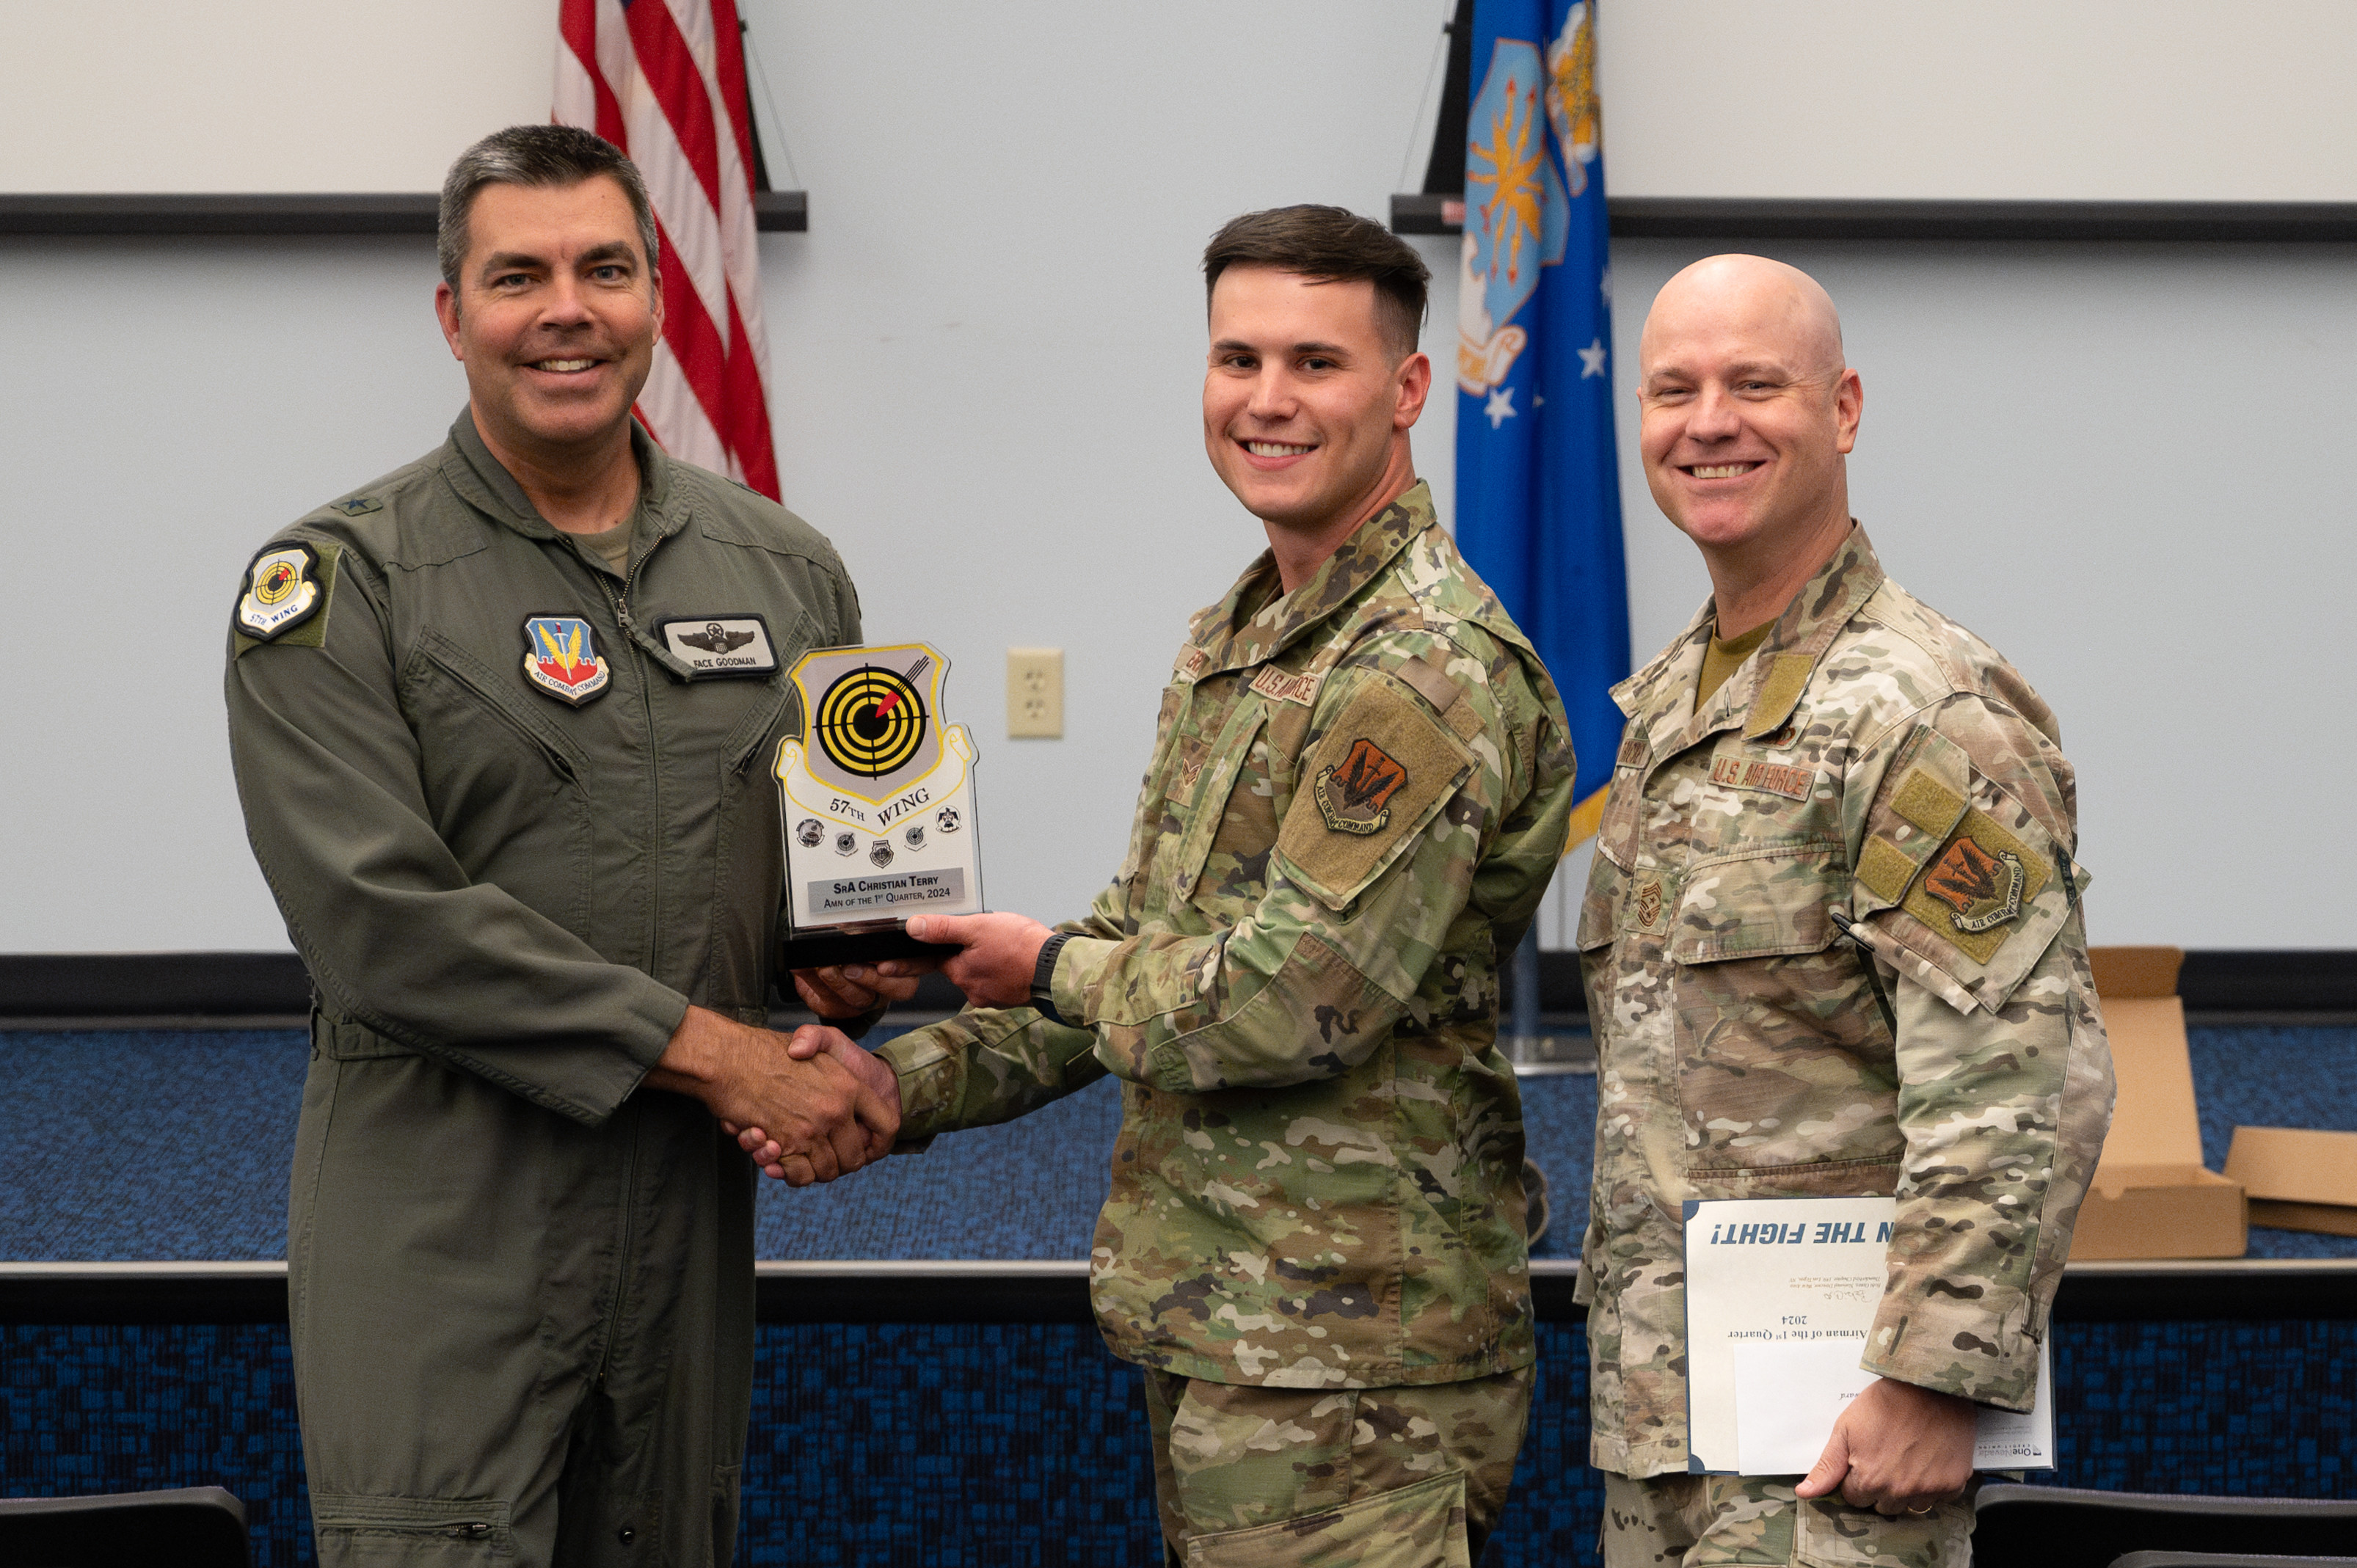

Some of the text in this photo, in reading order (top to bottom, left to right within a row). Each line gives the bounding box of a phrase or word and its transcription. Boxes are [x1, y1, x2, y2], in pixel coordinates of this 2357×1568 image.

[270, 604, 299, 624] WING
[693, 657, 757, 668] FACE GOODMAN
[534, 670, 605, 696] AIR COMBAT COMMAND
[1255, 667, 1285, 695] U.S.
[1713, 758, 1741, 784] U.S.
[829, 787, 930, 826] 57TH WING
[927, 887, 951, 899] 2024
[1971, 918, 1986, 930] AIR
[1710, 1222, 1895, 1245] N THE FIGHT!
[1782, 1316, 1807, 1325] 2024
[1727, 1329, 1868, 1341] Airman of the 1st Quarter
[1837, 1393, 1860, 1401] ward
